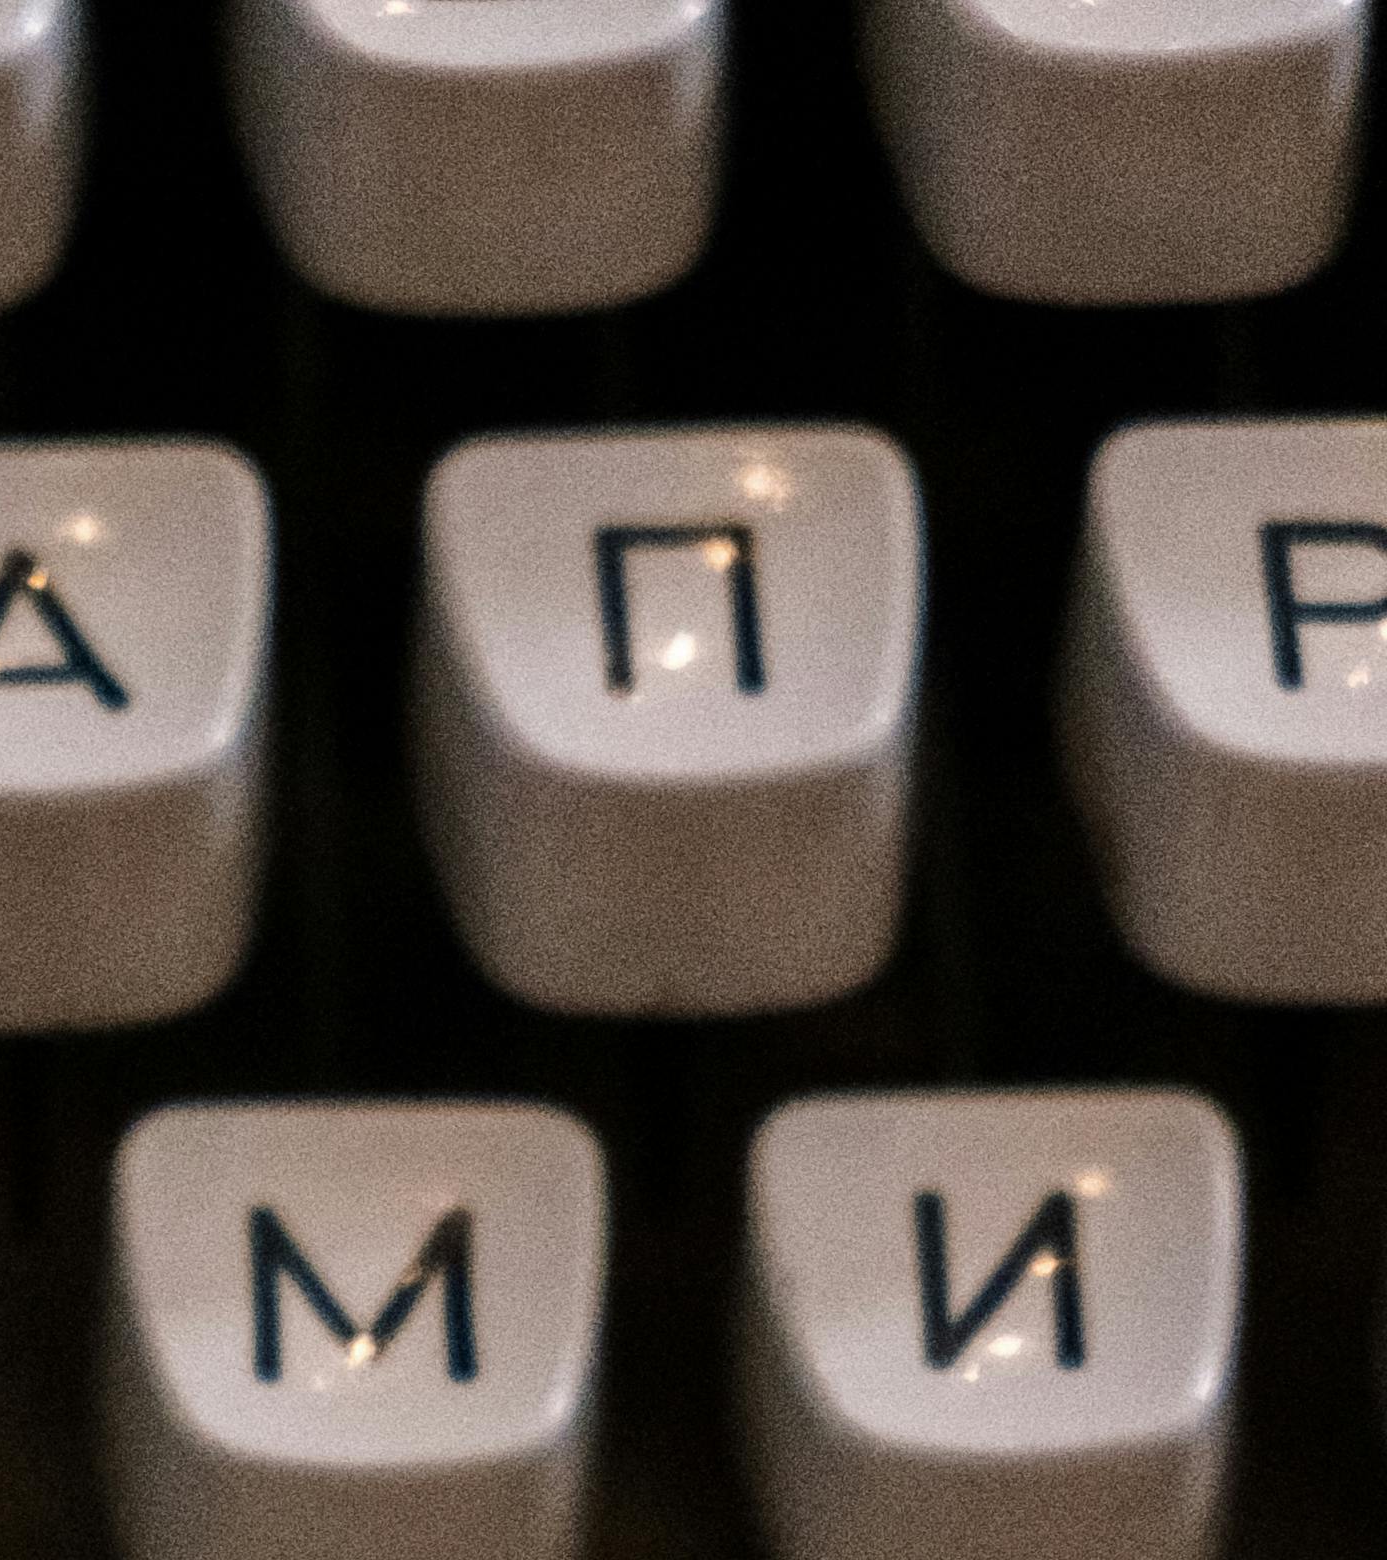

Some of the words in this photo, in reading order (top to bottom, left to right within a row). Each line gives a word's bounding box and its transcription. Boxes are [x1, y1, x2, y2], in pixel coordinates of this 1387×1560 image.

[590, 520, 767, 697] П
[1258, 517, 1387, 689] Р
[249, 1206, 479, 1384] М
[912, 1189, 1086, 1370] И
